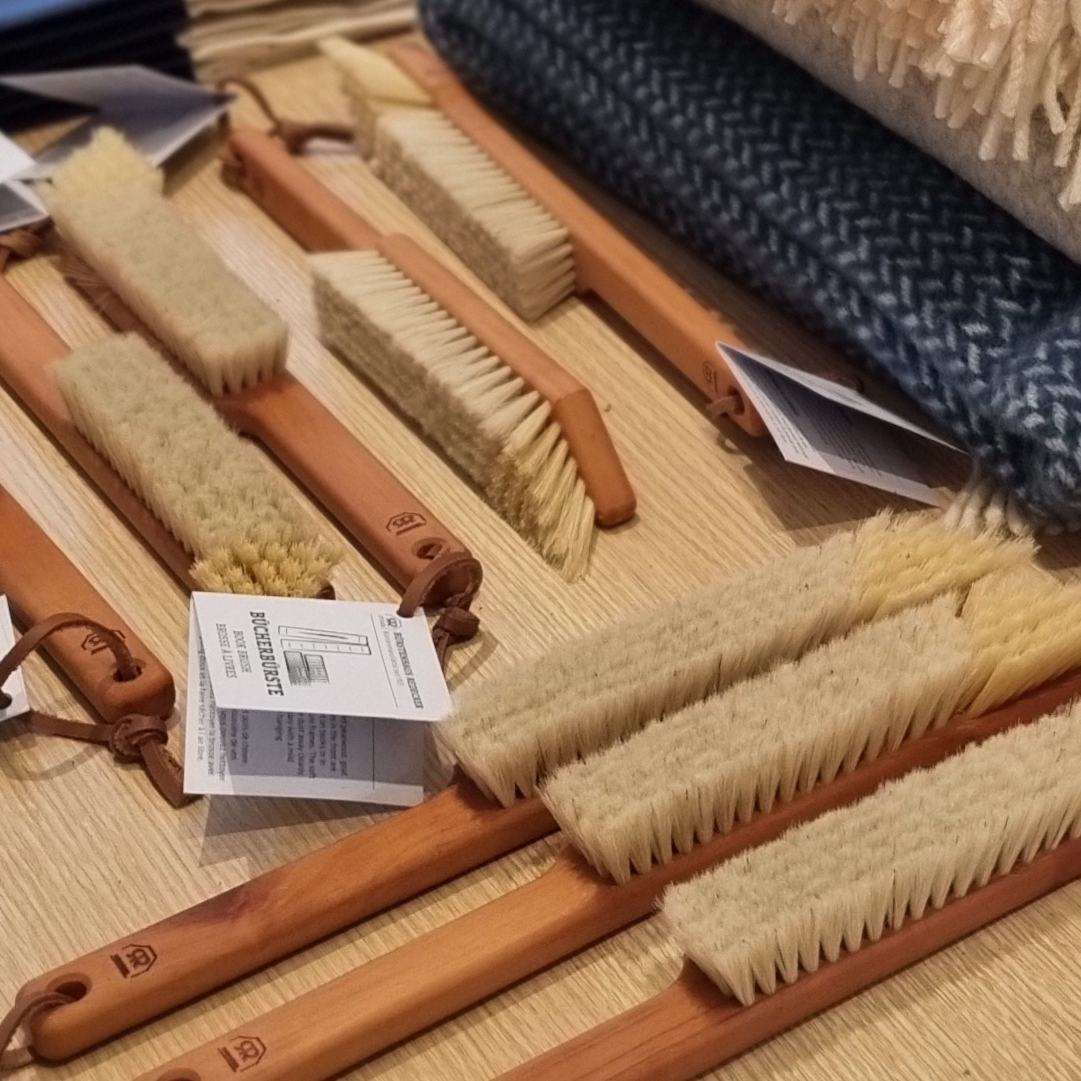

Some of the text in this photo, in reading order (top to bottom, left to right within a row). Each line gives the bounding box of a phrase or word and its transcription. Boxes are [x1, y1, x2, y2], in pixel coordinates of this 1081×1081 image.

[233, 630, 247, 649] BOOK
[250, 611, 284, 696] BÜCHERBÜRSTE
[223, 655, 238, 678] LIVRES
